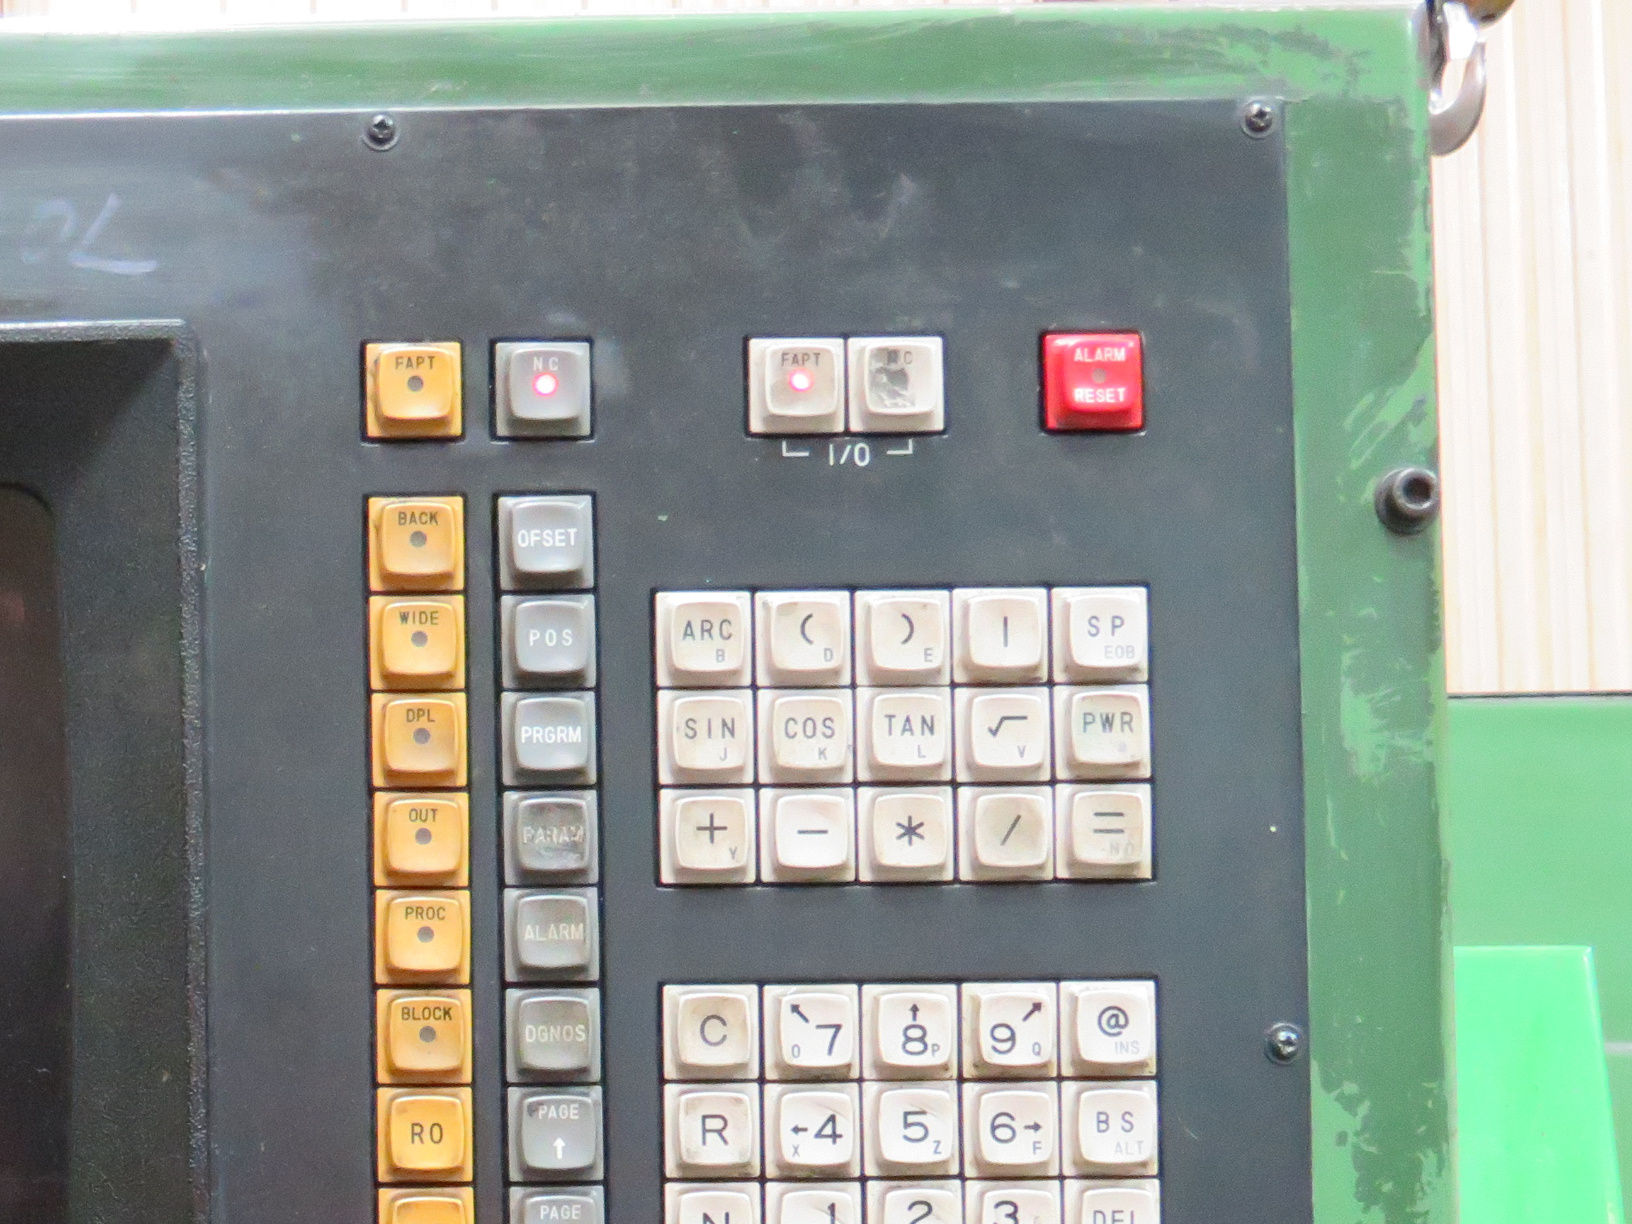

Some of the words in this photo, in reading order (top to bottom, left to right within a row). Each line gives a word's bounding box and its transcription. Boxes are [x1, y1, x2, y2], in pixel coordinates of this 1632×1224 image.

[395, 355, 436, 370] FAPT
[780, 353, 821, 367] FAPT
[1073, 347, 1126, 362] ALARM
[1074, 388, 1125, 403] RESET
[828, 442, 870, 467] I/O
[397, 511, 439, 527] BACK
[517, 529, 577, 547] OFSET
[398, 611, 439, 626] WIDE
[528, 629, 573, 647] POS
[682, 619, 732, 641] ARC
[716, 649, 726, 663] B
[924, 648, 934, 662] E
[405, 708, 436, 723] DPL
[1083, 712, 1134, 734] PWR
[684, 718, 735, 739] SIN
[784, 718, 835, 739] COS
[884, 715, 935, 736] TAN
[521, 726, 582, 744] PRGRM
[408, 808, 439, 823] OUT
[404, 906, 446, 920] PROC
[524, 924, 585, 941] ALARM
[401, 1006, 453, 1021] BLOCK
[1097, 1006, 1130, 1037] @
[525, 1025, 587, 1042] DGNOS
[700, 1014, 728, 1047] C
[990, 1023, 1017, 1055] 9
[815, 1024, 843, 1056] 7
[902, 1024, 928, 1056] 8
[1115, 1040, 1140, 1055] INS
[931, 1043, 941, 1058] P
[538, 1105, 580, 1120] PAGE
[701, 1114, 729, 1146] R
[813, 1114, 843, 1145] 4
[902, 1111, 929, 1143] 5
[990, 1112, 1017, 1144] 6
[1114, 1141, 1144, 1156] ALT
[540, 1205, 582, 1220] PAGE
